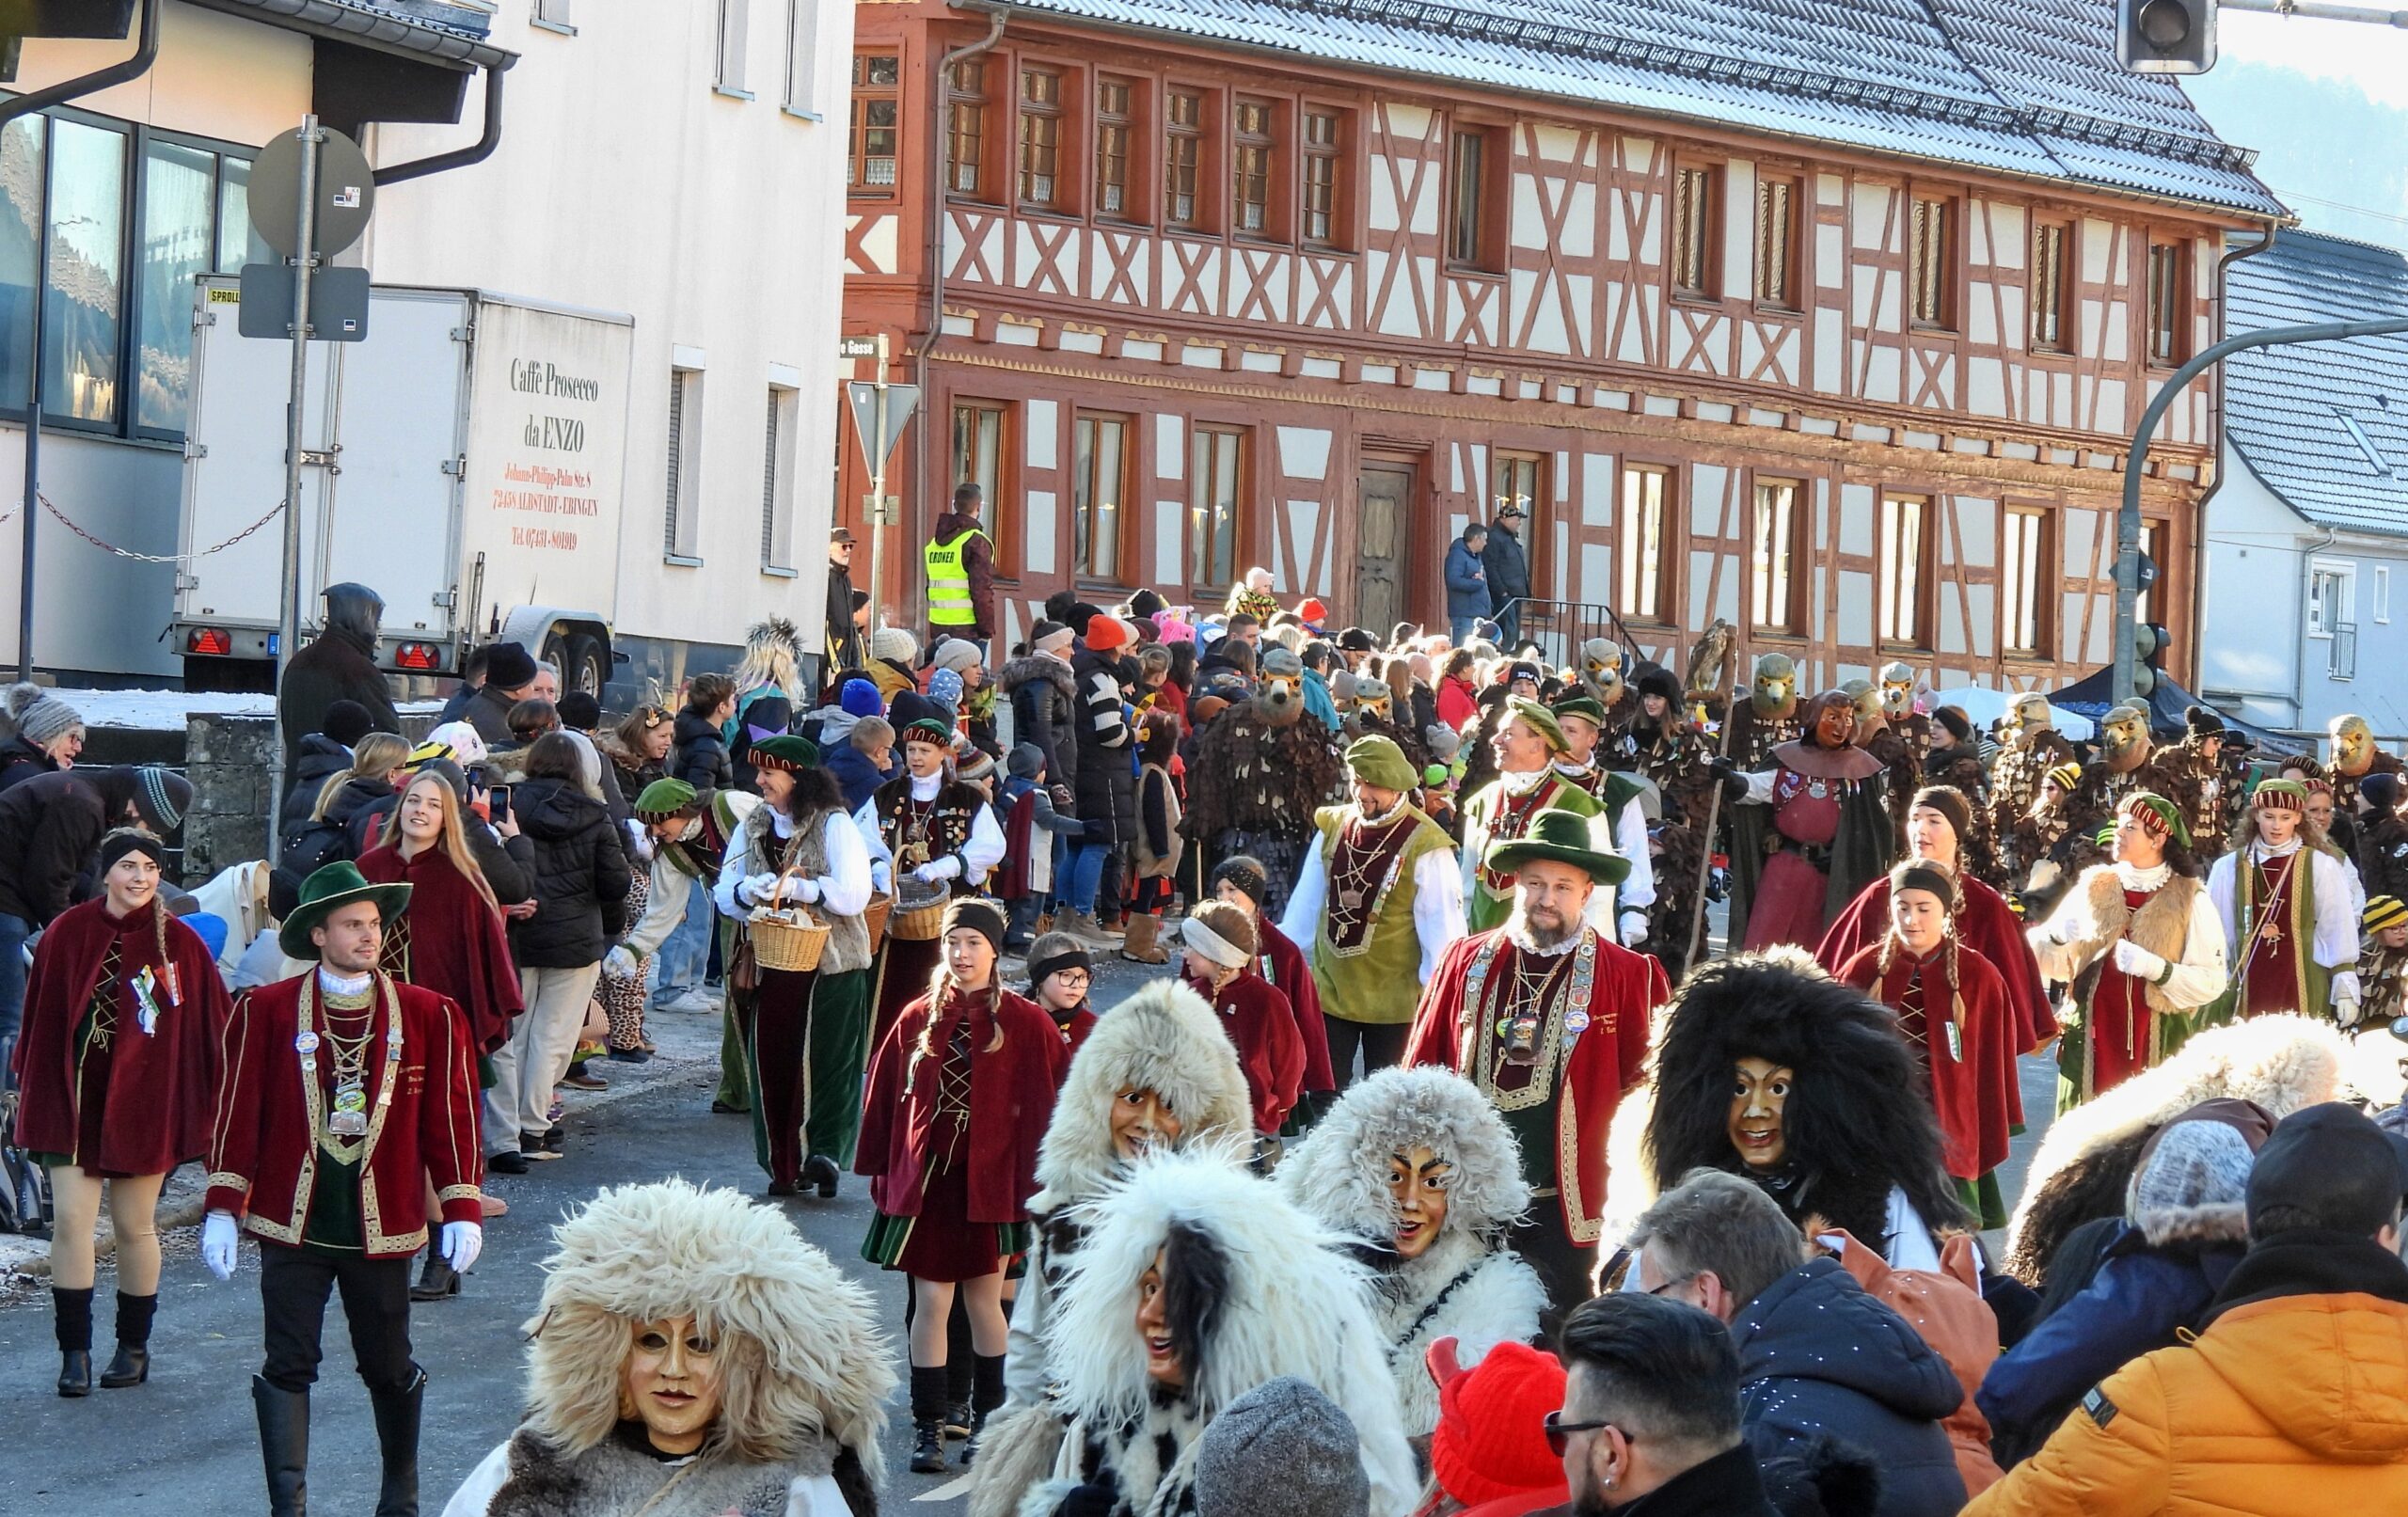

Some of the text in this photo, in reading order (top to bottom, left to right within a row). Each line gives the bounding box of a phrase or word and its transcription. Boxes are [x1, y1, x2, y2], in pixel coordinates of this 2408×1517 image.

[848, 340, 874, 355] Gasse
[545, 362, 598, 403] Prosecco
[524, 414, 584, 452] da ENZO
[493, 489, 516, 511] 72458
[512, 527, 525, 545] Tel.
